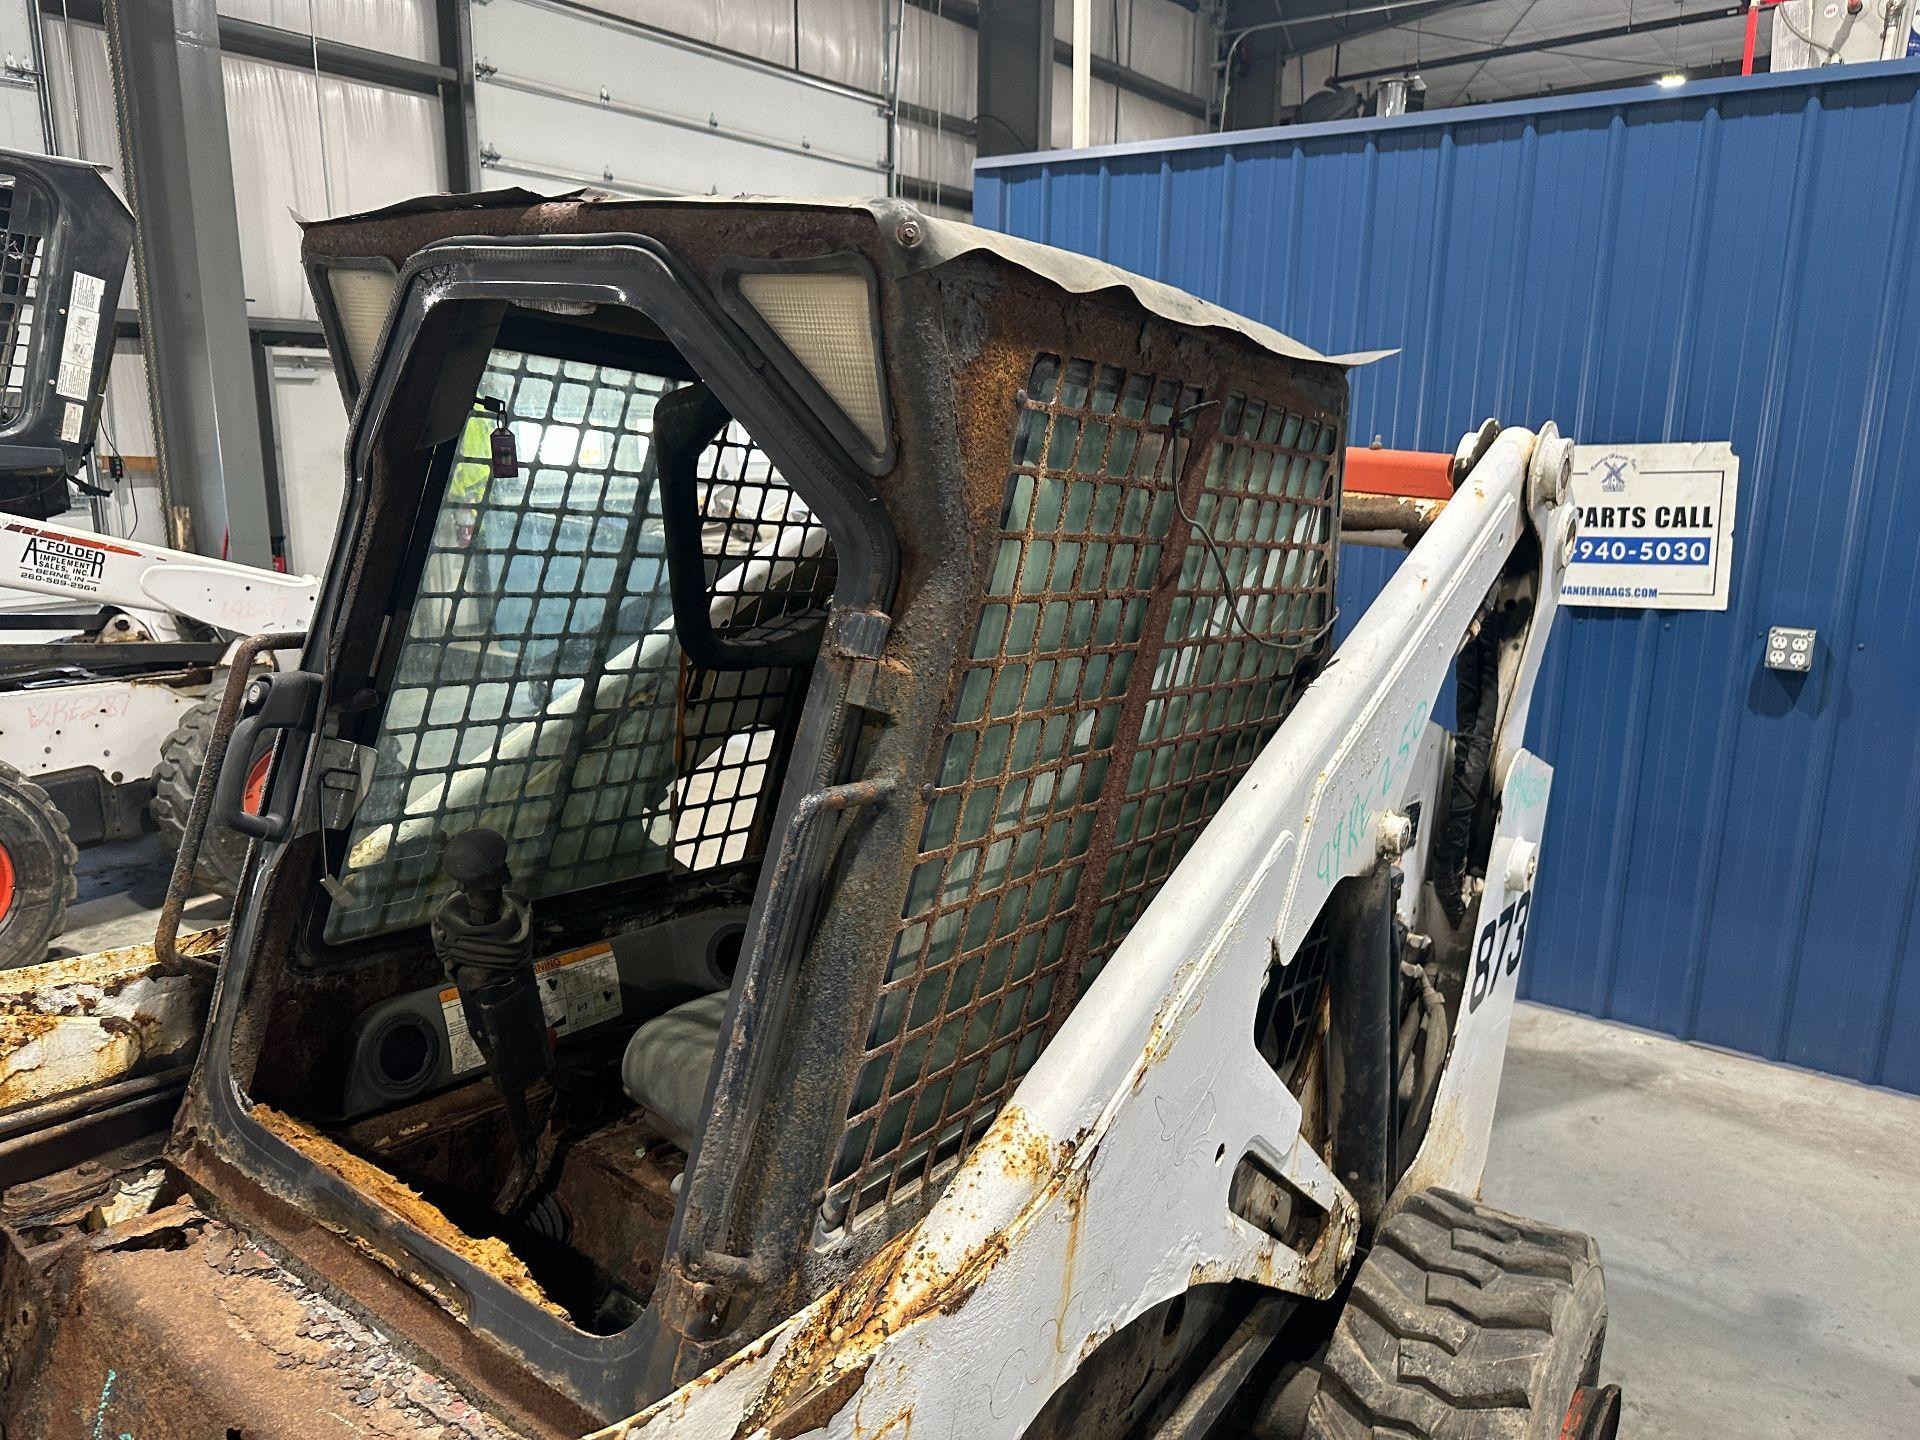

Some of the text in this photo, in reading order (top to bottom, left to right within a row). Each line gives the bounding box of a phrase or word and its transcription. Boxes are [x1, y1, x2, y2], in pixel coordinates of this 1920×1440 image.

[1654, 506, 1713, 528] CALL
[38, 560, 69, 574] SALES,
[39, 553, 91, 570] IMPLEMENT
[35, 567, 72, 581] BERNE,
[1561, 585, 1658, 599] VANDERHAAGS.COM
[1469, 889, 1531, 1014] 873
